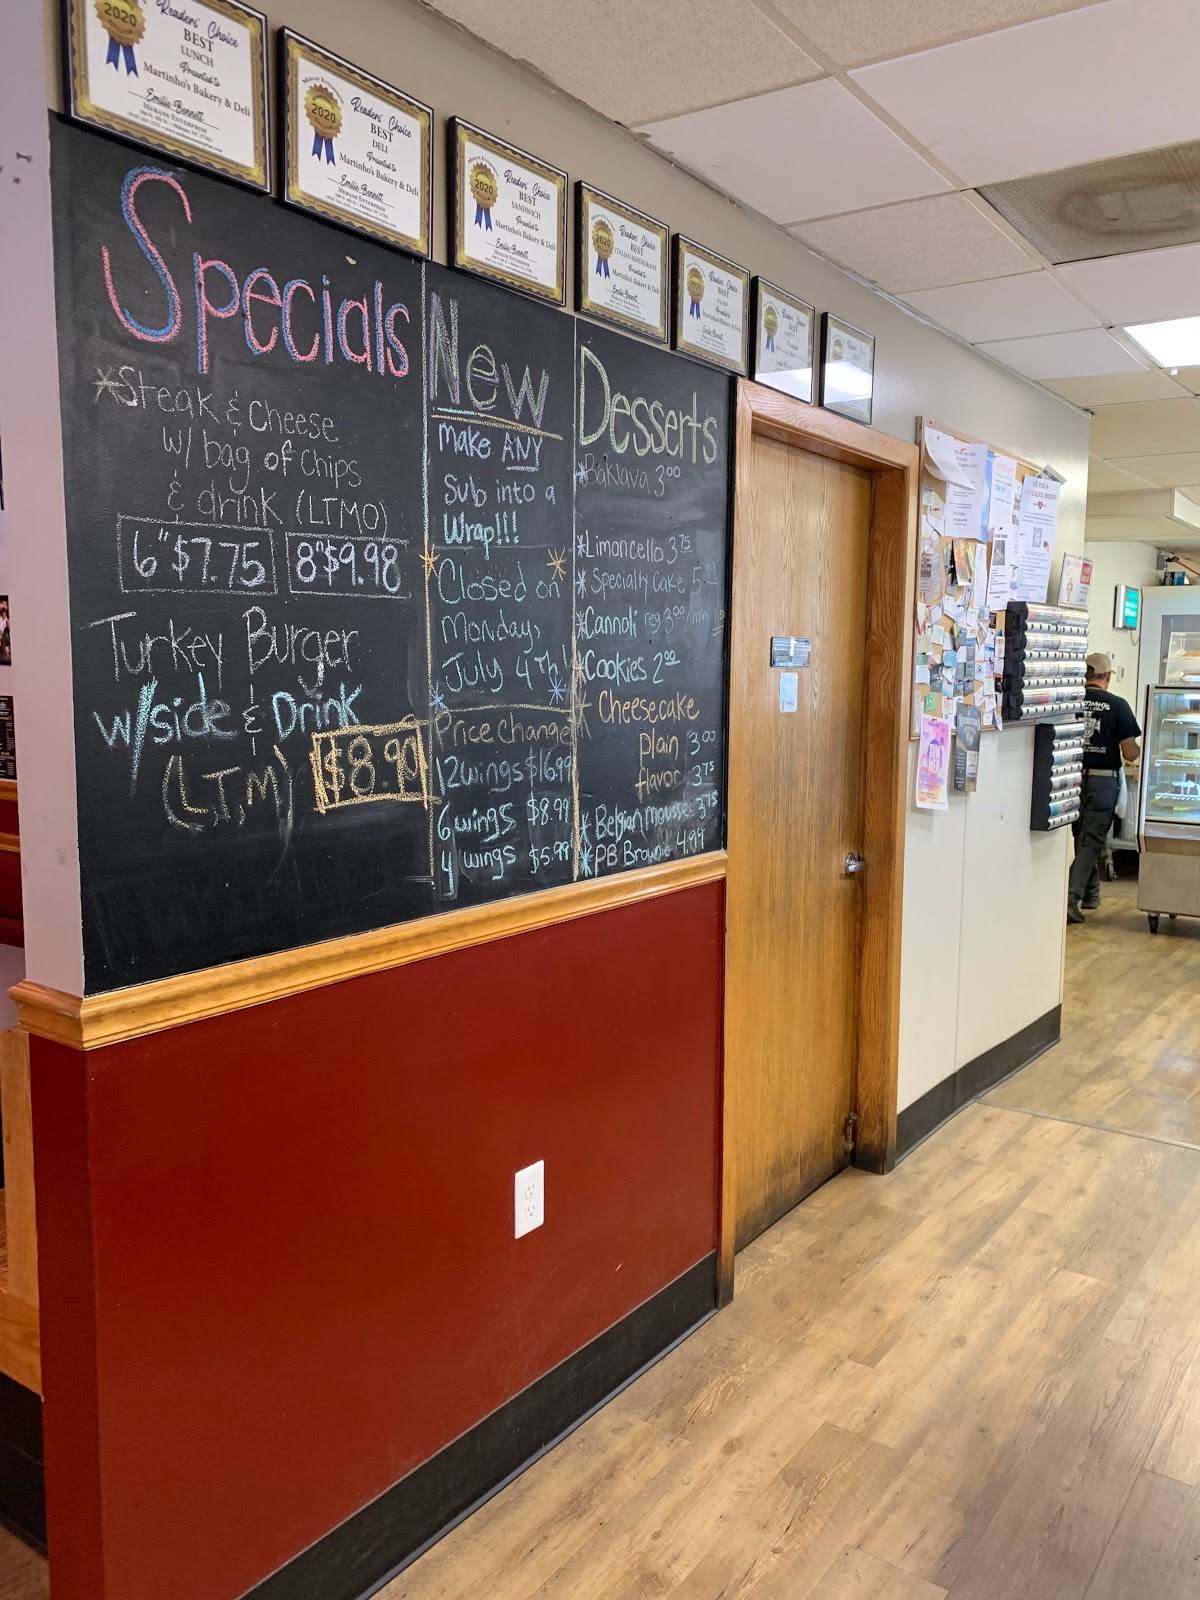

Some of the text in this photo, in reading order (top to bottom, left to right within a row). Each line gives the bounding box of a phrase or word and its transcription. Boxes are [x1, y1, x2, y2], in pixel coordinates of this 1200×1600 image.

[104, 2, 137, 27] 2020
[184, 28, 214, 52] BEST
[208, 21, 239, 48] Choice
[181, 45, 214, 68] LUNCH
[143, 61, 251, 117] Martinho's Bakery & Deli
[311, 103, 336, 124] 2020
[388, 115, 412, 138] Choice
[370, 122, 394, 142] BEST
[372, 138, 389, 154] DELI
[339, 152, 419, 197] Martinho's Bakery & Deli
[474, 178, 494, 196] 2020
[532, 182, 551, 201] Choice
[511, 200, 541, 221] SANDWICH
[519, 191, 536, 207] BEST
[495, 219, 522, 239] Martinho's
[522, 230, 540, 247] Bakery
[546, 239, 556, 250] Deli
[596, 233, 611, 248] 2020
[630, 243, 644, 257] BEST
[102, 166, 410, 378] Specials
[429, 291, 549, 429] New
[226, 390, 243, 436] &
[249, 400, 339, 443] Cheese
[579, 345, 717, 464] Desserts
[203, 429, 250, 495] bag
[264, 440, 296, 477] of
[301, 448, 362, 489] Chips
[502, 432, 543, 468] ANY
[444, 472, 555, 508] Sub into a
[585, 452, 651, 495] Baklava
[167, 469, 389, 542] & drink (LTMO)
[443, 510, 519, 561] Wrap!!!
[586, 529, 663, 562] Limoncello
[438, 558, 560, 604] Closed on
[591, 567, 648, 603] Specialty
[653, 570, 685, 593] Cake
[585, 604, 637, 640] Cannoli
[84, 605, 359, 700] Turkey Burger
[584, 649, 647, 687] Cookies
[442, 650, 503, 694] July
[242, 684, 263, 756] &
[271, 681, 362, 742] Drink
[598, 688, 700, 725] Cheesecake
[434, 711, 496, 752] Price
[635, 768, 680, 803] flavor
[437, 791, 569, 843] 6 wings $8.99
[595, 803, 643, 844] Belgian
[463, 845, 517, 881] wings
[528, 841, 569, 875] $5.99
[595, 843, 618, 877] PB
[676, 827, 705, 856] 4.99
